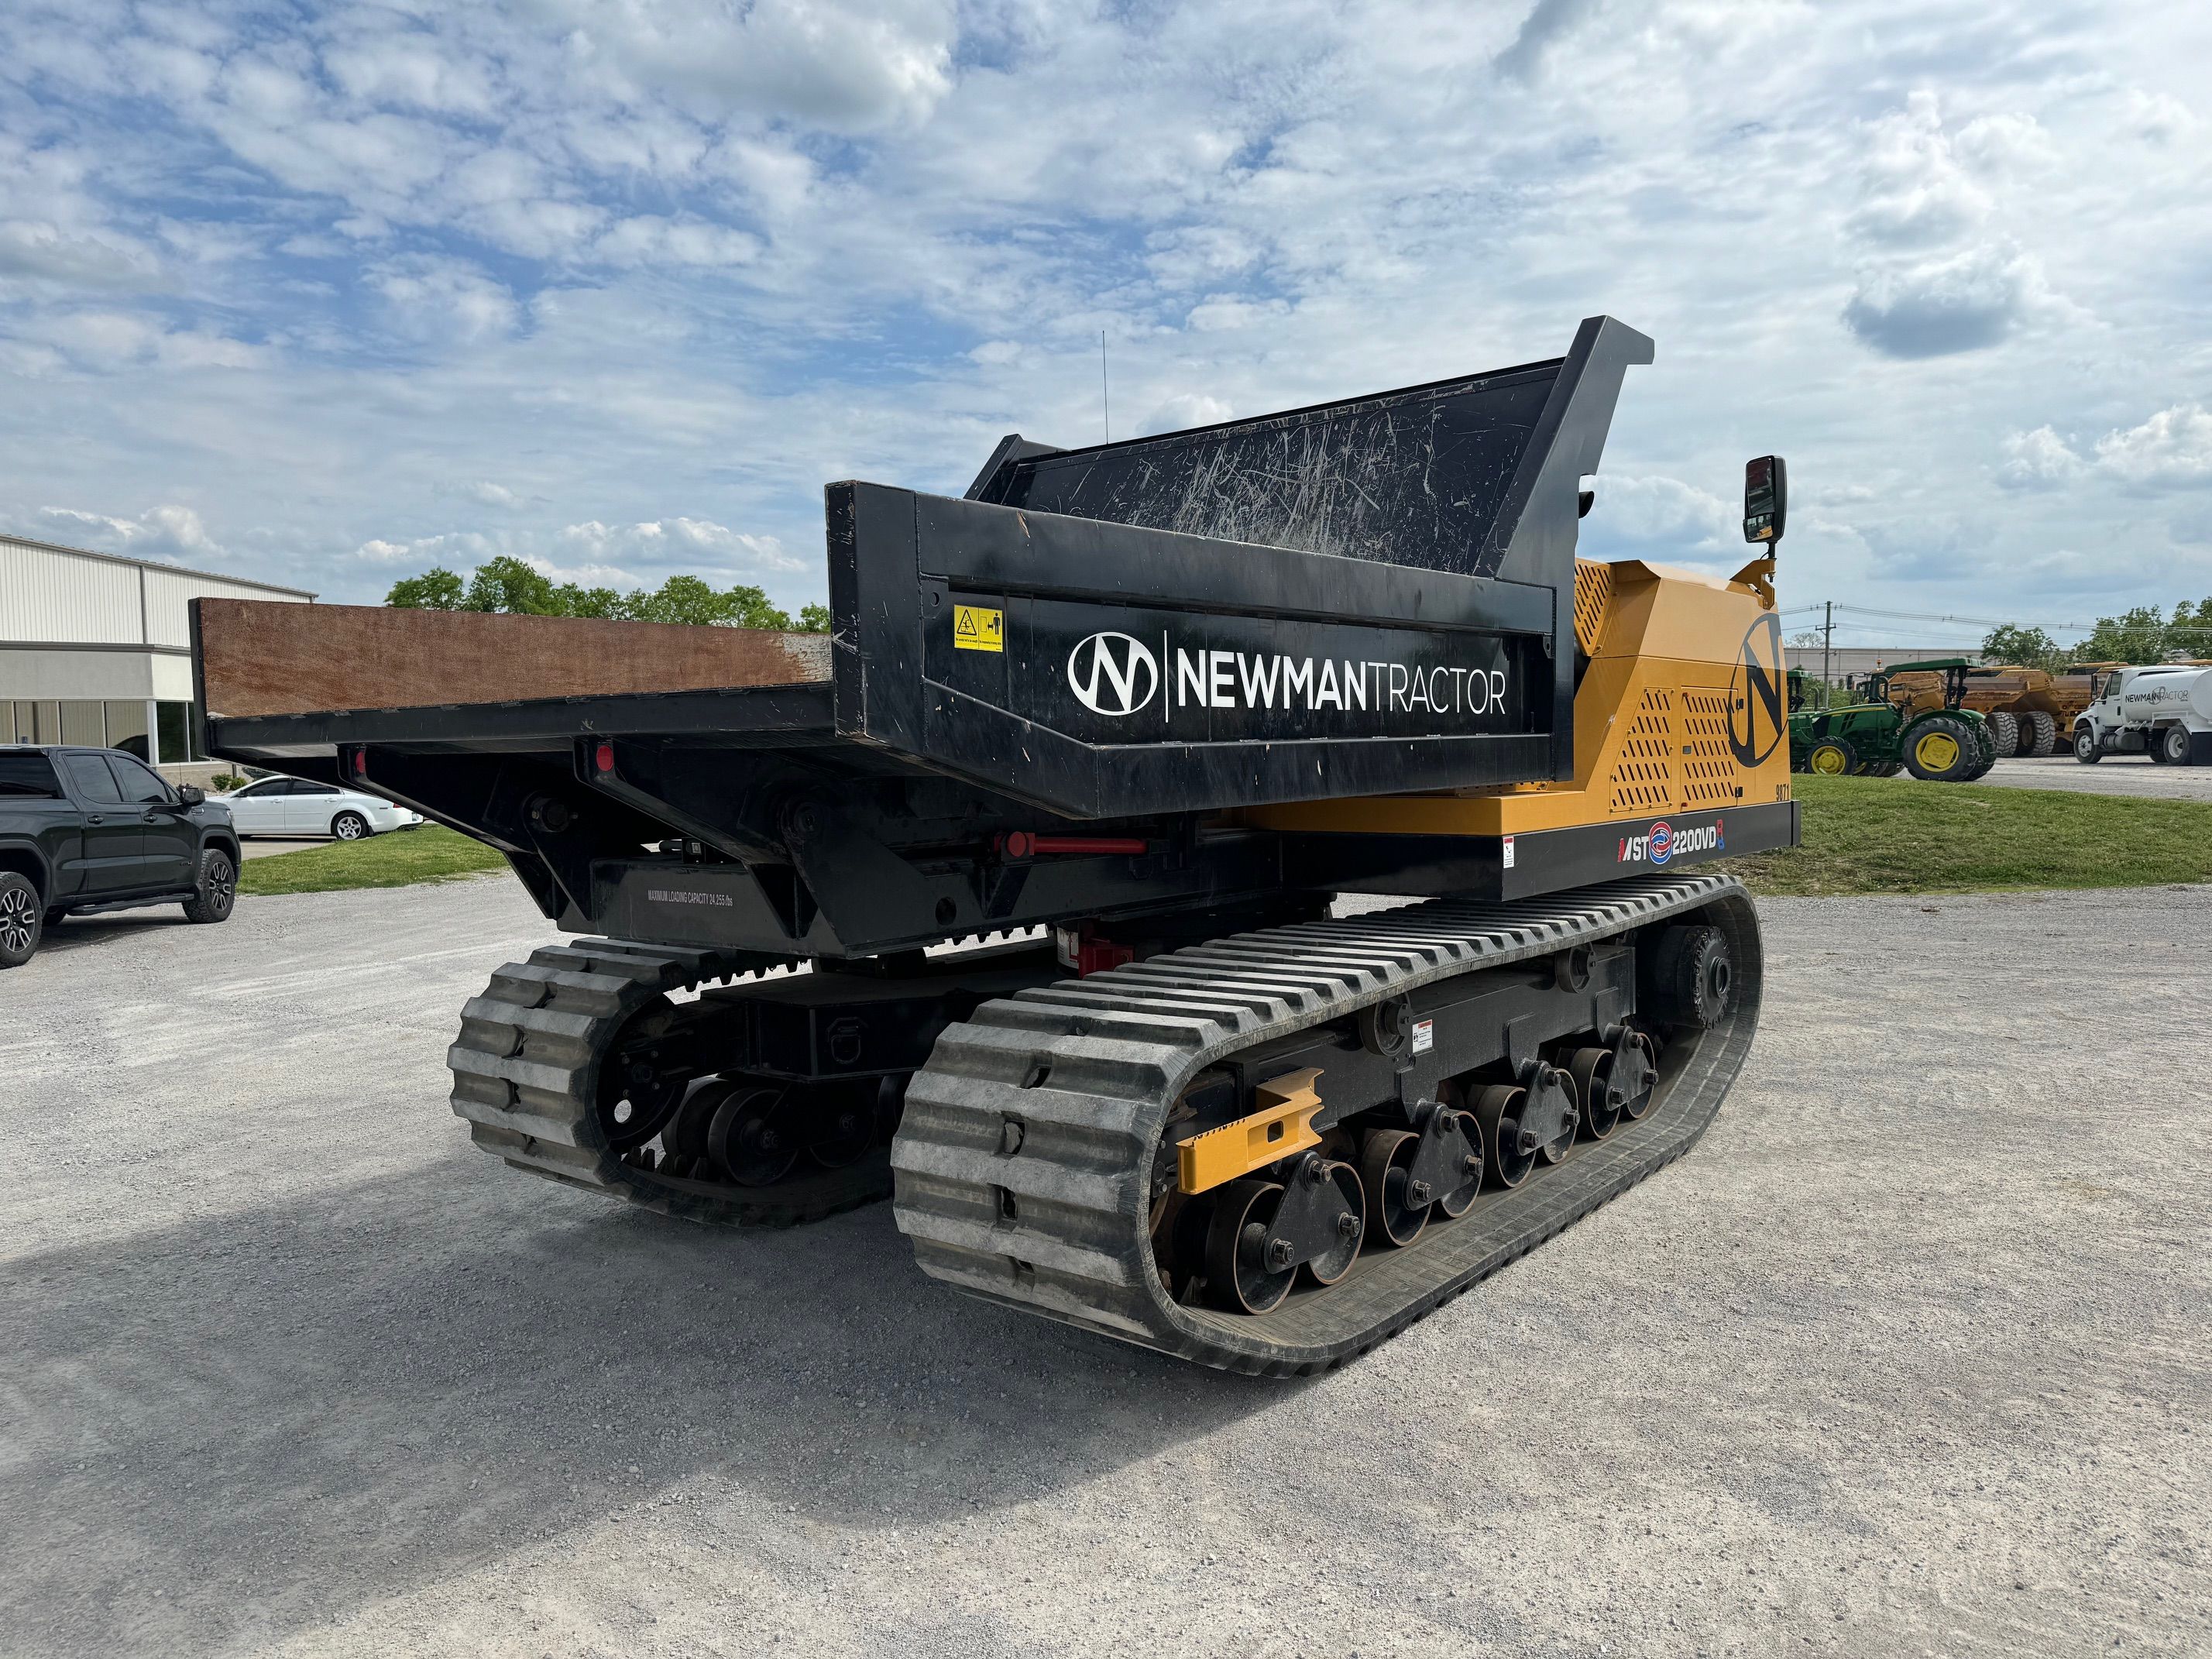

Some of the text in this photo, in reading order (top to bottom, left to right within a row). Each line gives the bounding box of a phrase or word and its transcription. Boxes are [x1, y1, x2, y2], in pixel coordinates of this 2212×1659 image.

[1776, 783, 1789, 802] 9871
[647, 889, 668, 902] MAXIMUM
[668, 891, 687, 903] LOADING
[688, 892, 709, 905] CAPACITY
